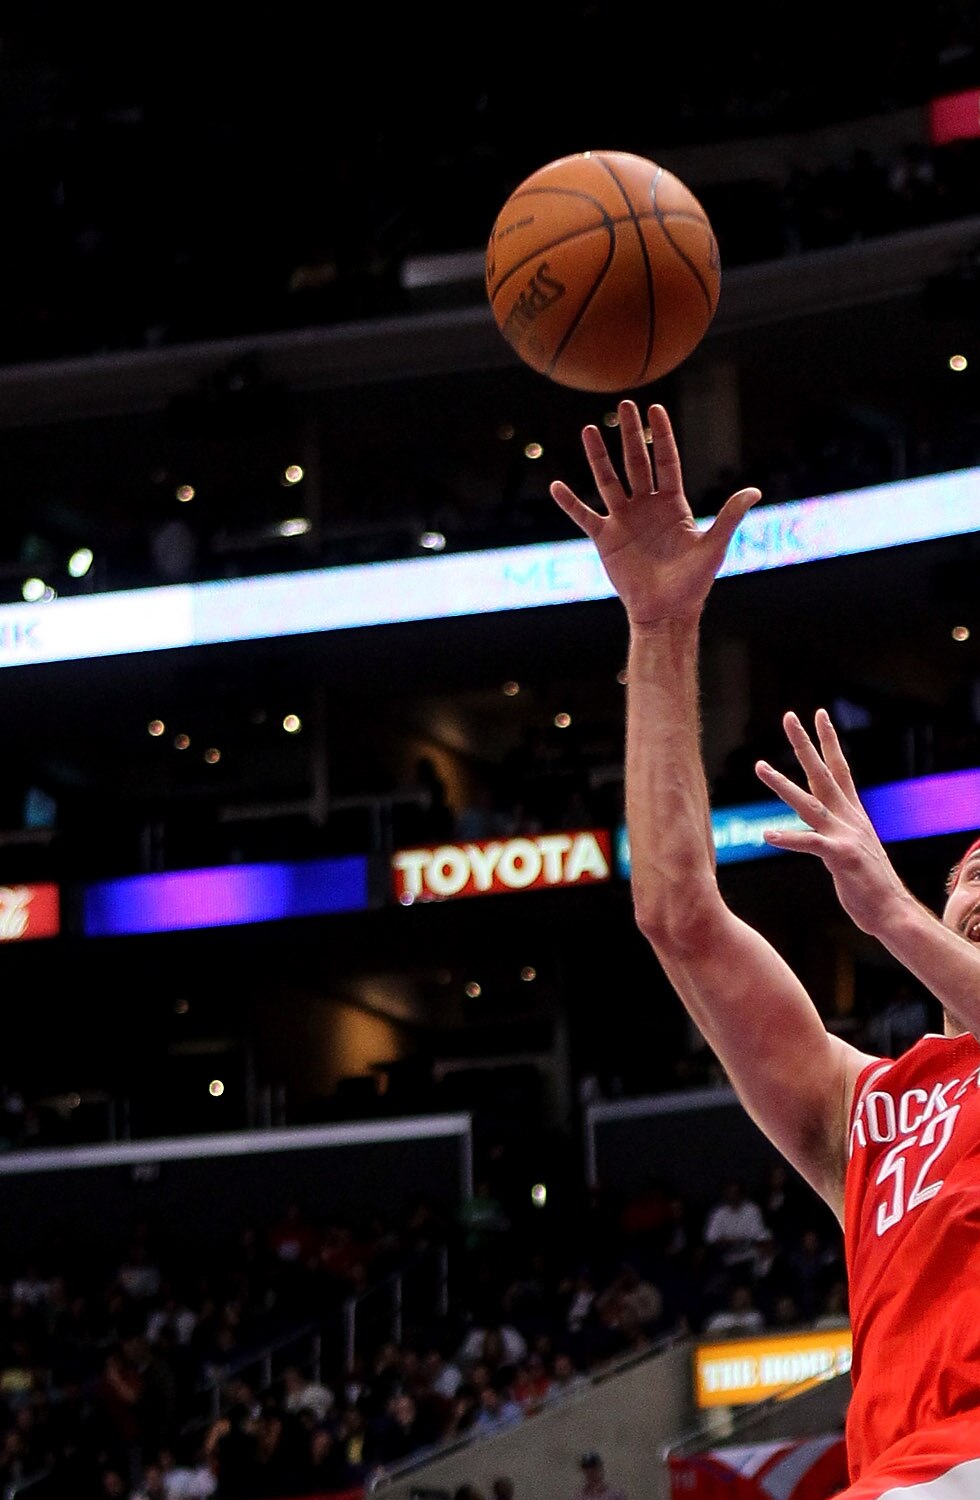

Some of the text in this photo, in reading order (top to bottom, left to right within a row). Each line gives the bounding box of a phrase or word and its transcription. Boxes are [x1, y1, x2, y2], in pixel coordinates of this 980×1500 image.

[393, 833, 609, 898] TOYOTA
[876, 1105, 960, 1237] 52
[702, 1358, 755, 1392] THE
